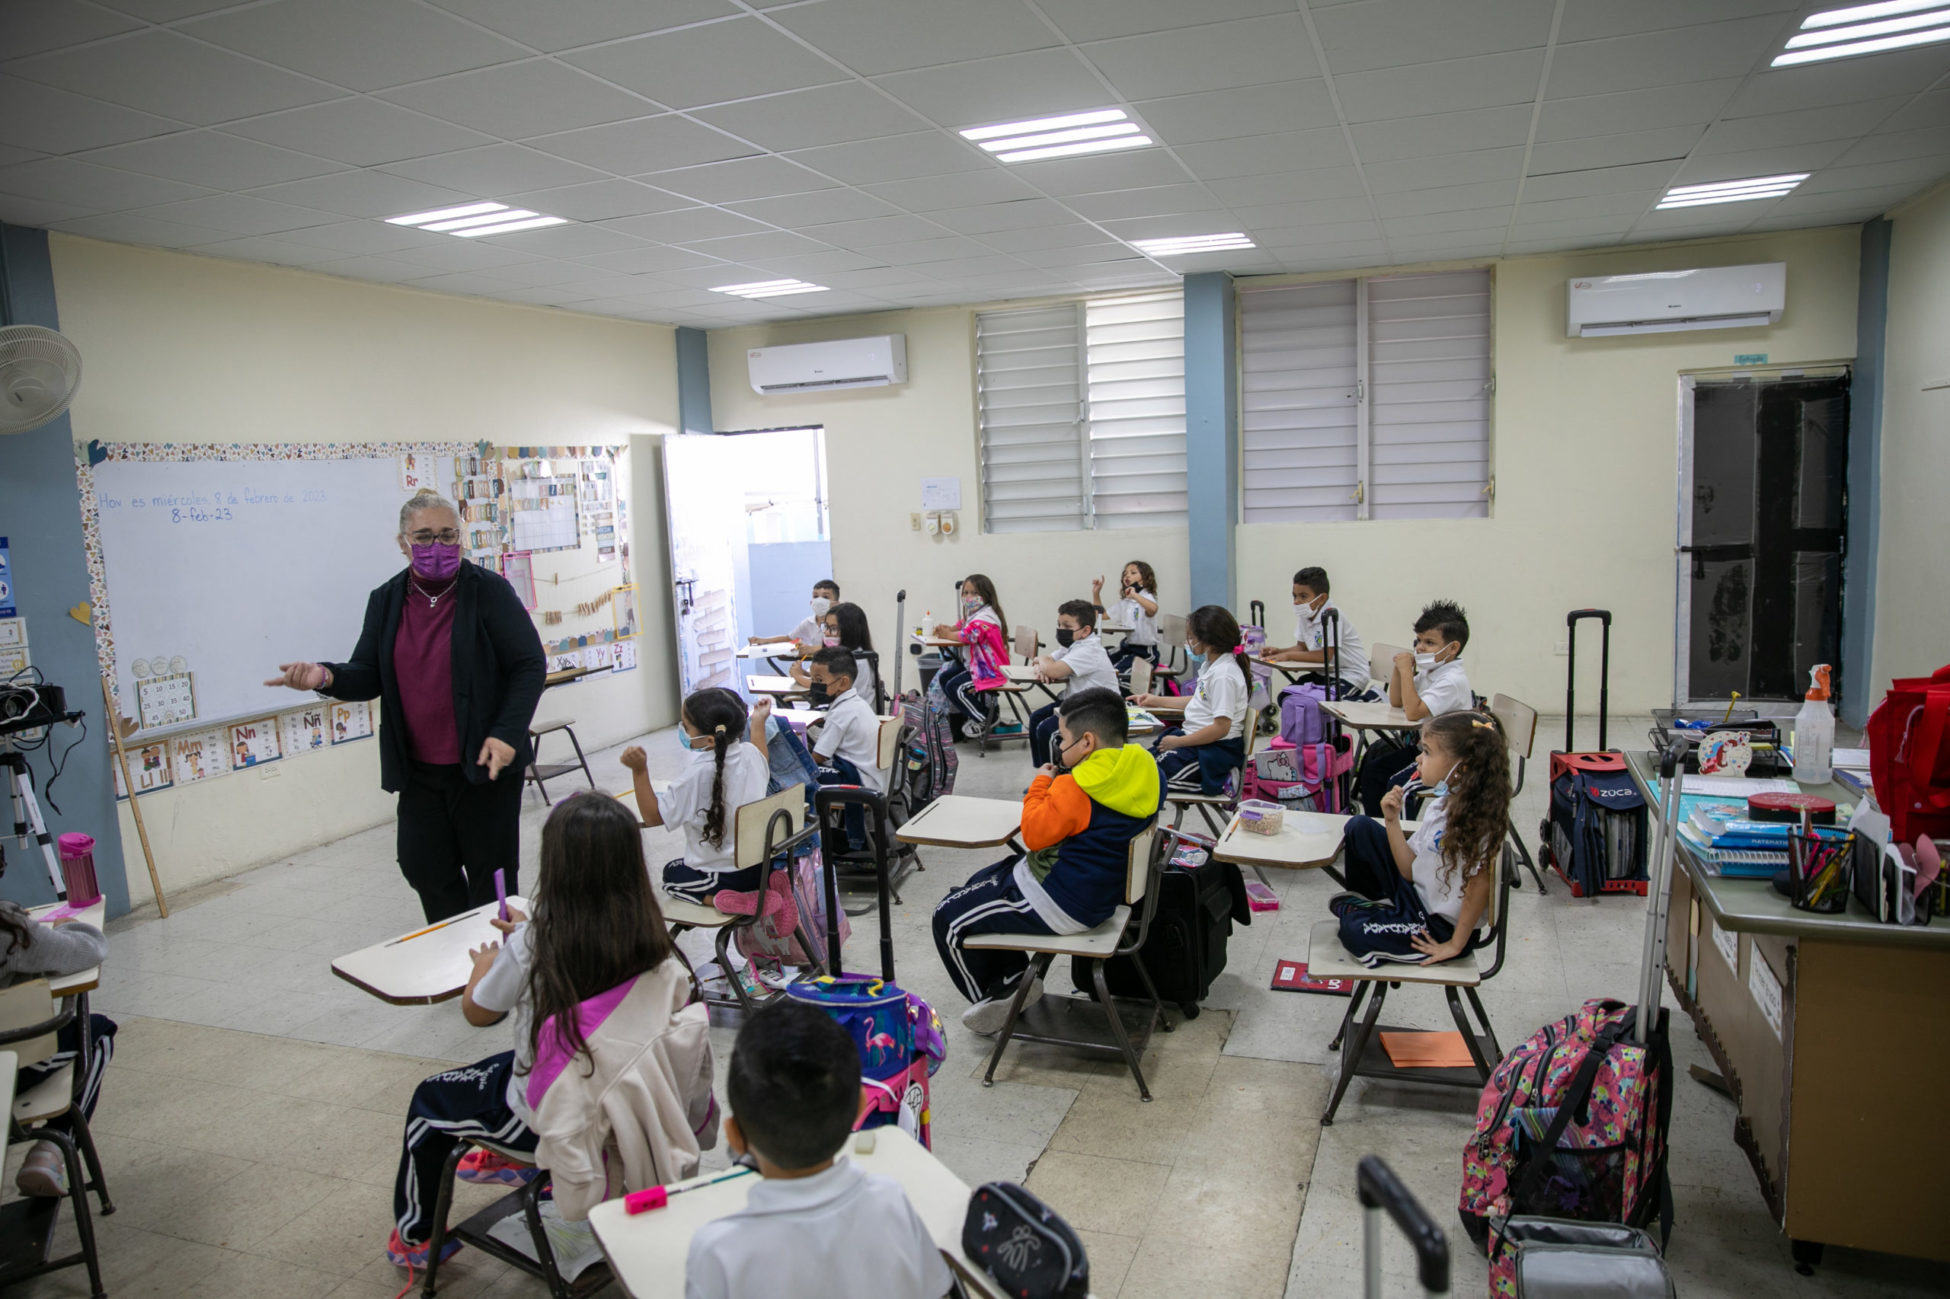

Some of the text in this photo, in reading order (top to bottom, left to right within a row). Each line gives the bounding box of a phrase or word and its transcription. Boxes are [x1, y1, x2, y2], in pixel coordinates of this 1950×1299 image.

[132, 499, 145, 507] es
[227, 492, 238, 505] de
[172, 507, 233, 524] 8-feb-23
[143, 688, 149, 696] 5
[156, 685, 163, 693] 10
[181, 680, 189, 688] 20
[304, 712, 322, 730] Ññ
[337, 707, 350, 723] Pp
[235, 726, 257, 742] Nn
[177, 740, 203, 756] Mm
